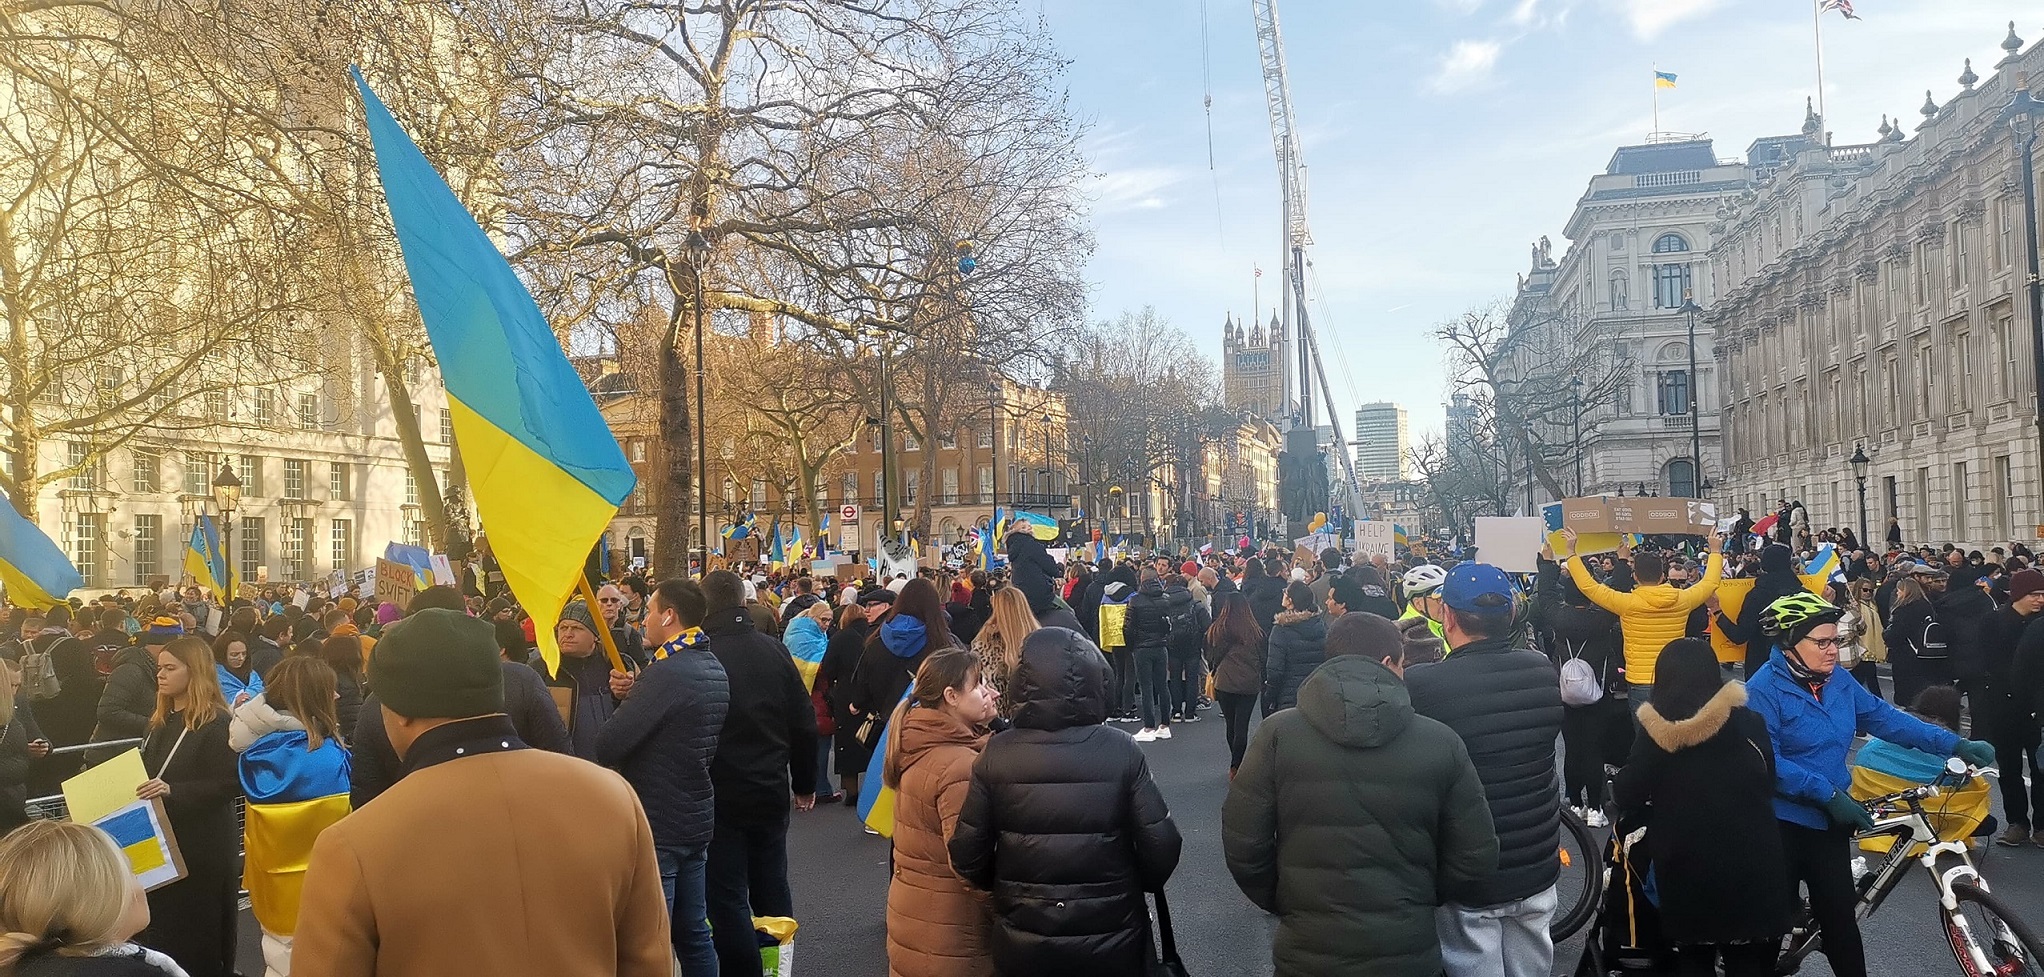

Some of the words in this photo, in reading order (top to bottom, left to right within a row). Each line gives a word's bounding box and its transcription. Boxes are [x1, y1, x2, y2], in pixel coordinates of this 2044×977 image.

[1570, 511, 1599, 519] ODDBOX
[1360, 523, 1386, 537] HELP
[380, 562, 413, 588] BLOCK
[378, 580, 410, 605] SWIFT
